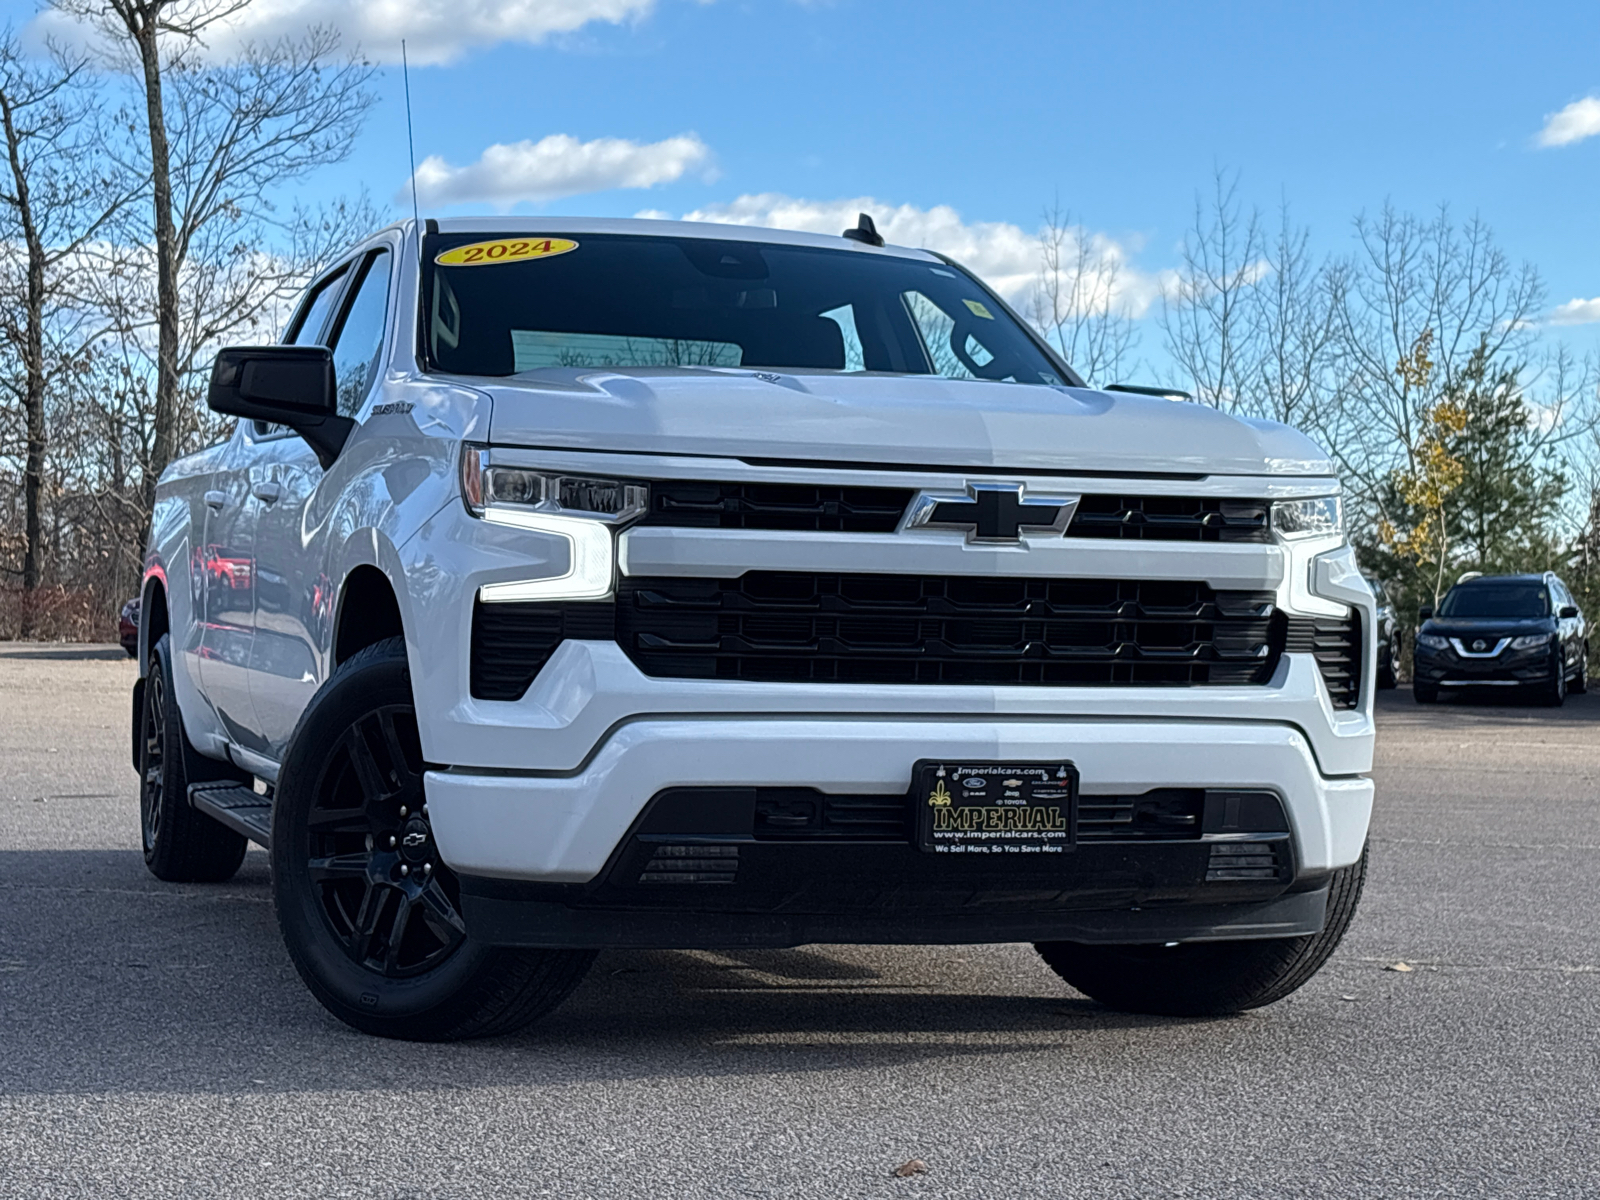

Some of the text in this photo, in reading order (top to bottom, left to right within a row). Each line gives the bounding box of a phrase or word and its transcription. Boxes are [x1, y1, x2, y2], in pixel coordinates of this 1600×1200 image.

[463, 240, 556, 263] 2024
[957, 767, 1045, 776] Imperialcars.com
[934, 806, 1066, 831] IMPERIAL
[934, 831, 1066, 839] www.imperialcars.com
[935, 845, 1062, 854] We Sell More, So You Save More
